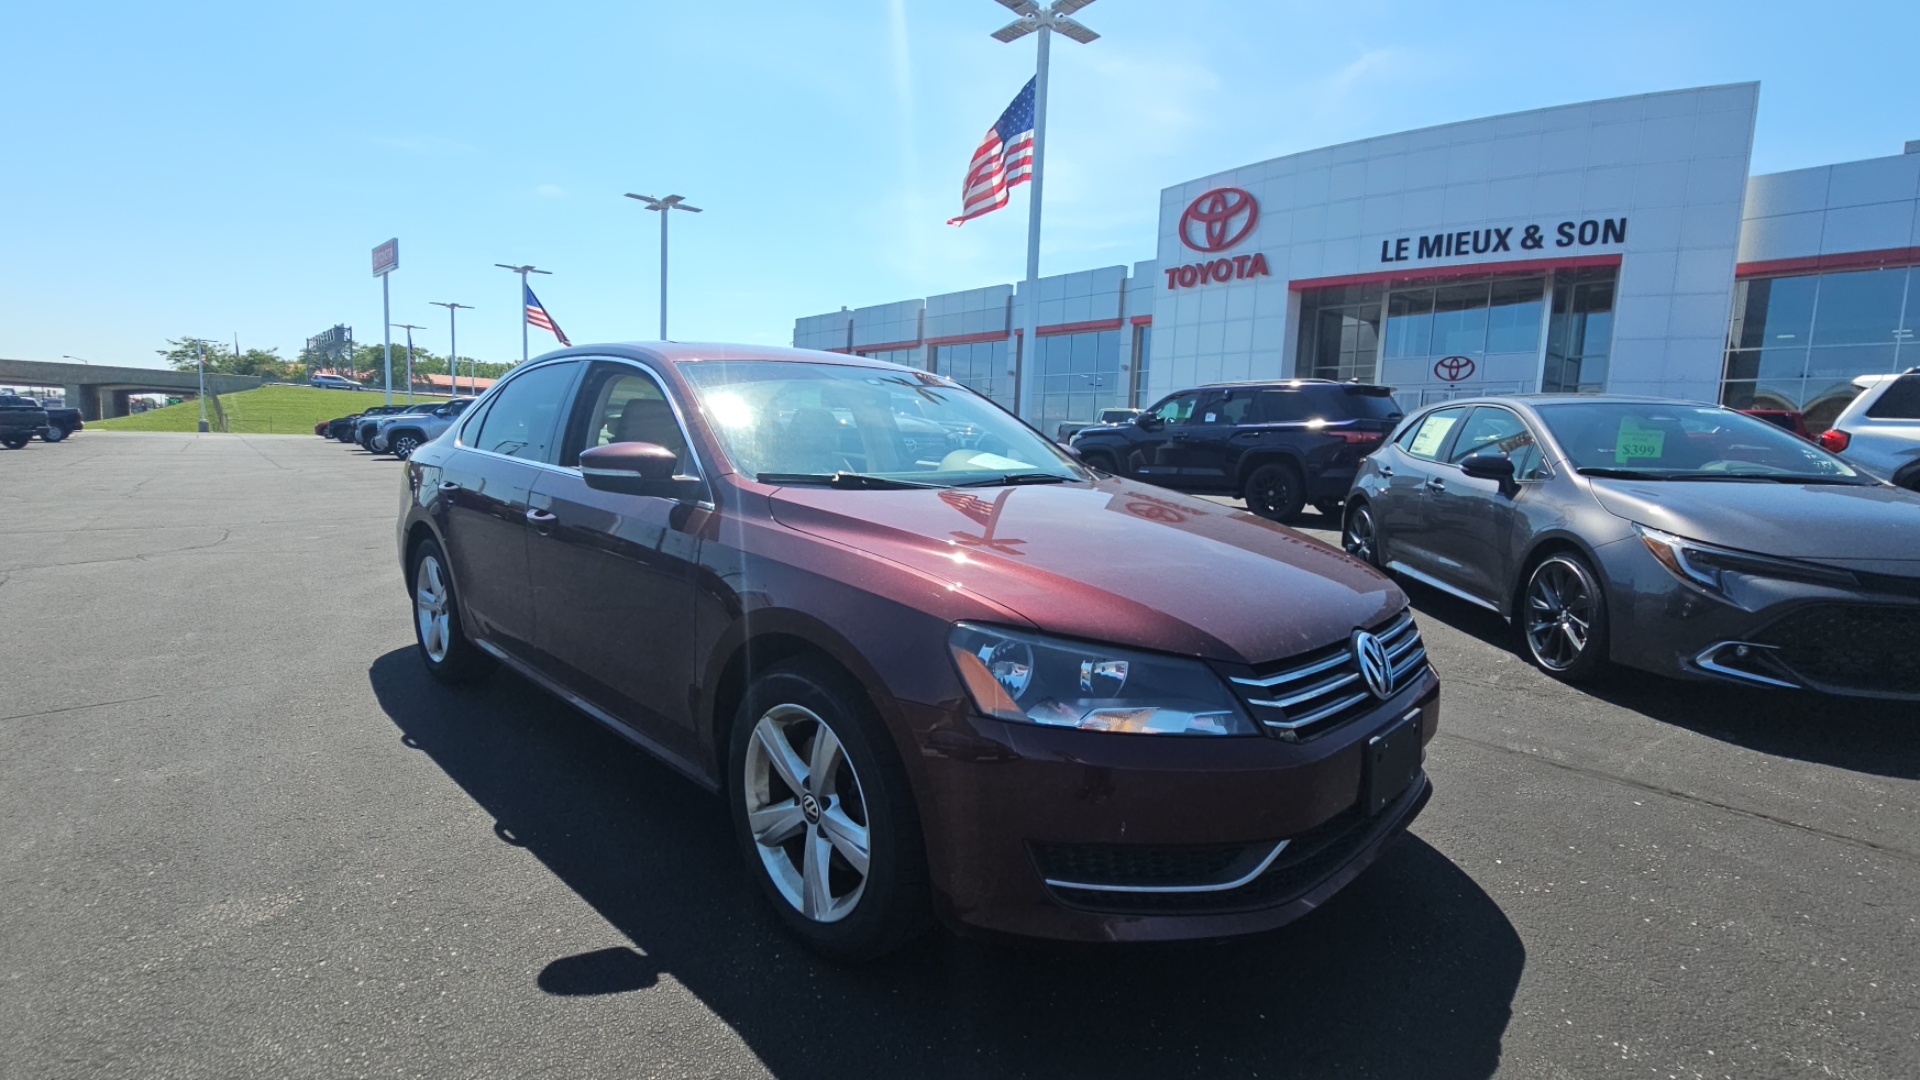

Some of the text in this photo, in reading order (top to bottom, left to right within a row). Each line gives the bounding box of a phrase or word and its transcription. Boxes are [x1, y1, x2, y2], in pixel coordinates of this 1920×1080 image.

[1381, 217, 1627, 263] LE MIEUX & SON
[1165, 252, 1270, 290] TOYOTA
[1622, 444, 1655, 455] $399
